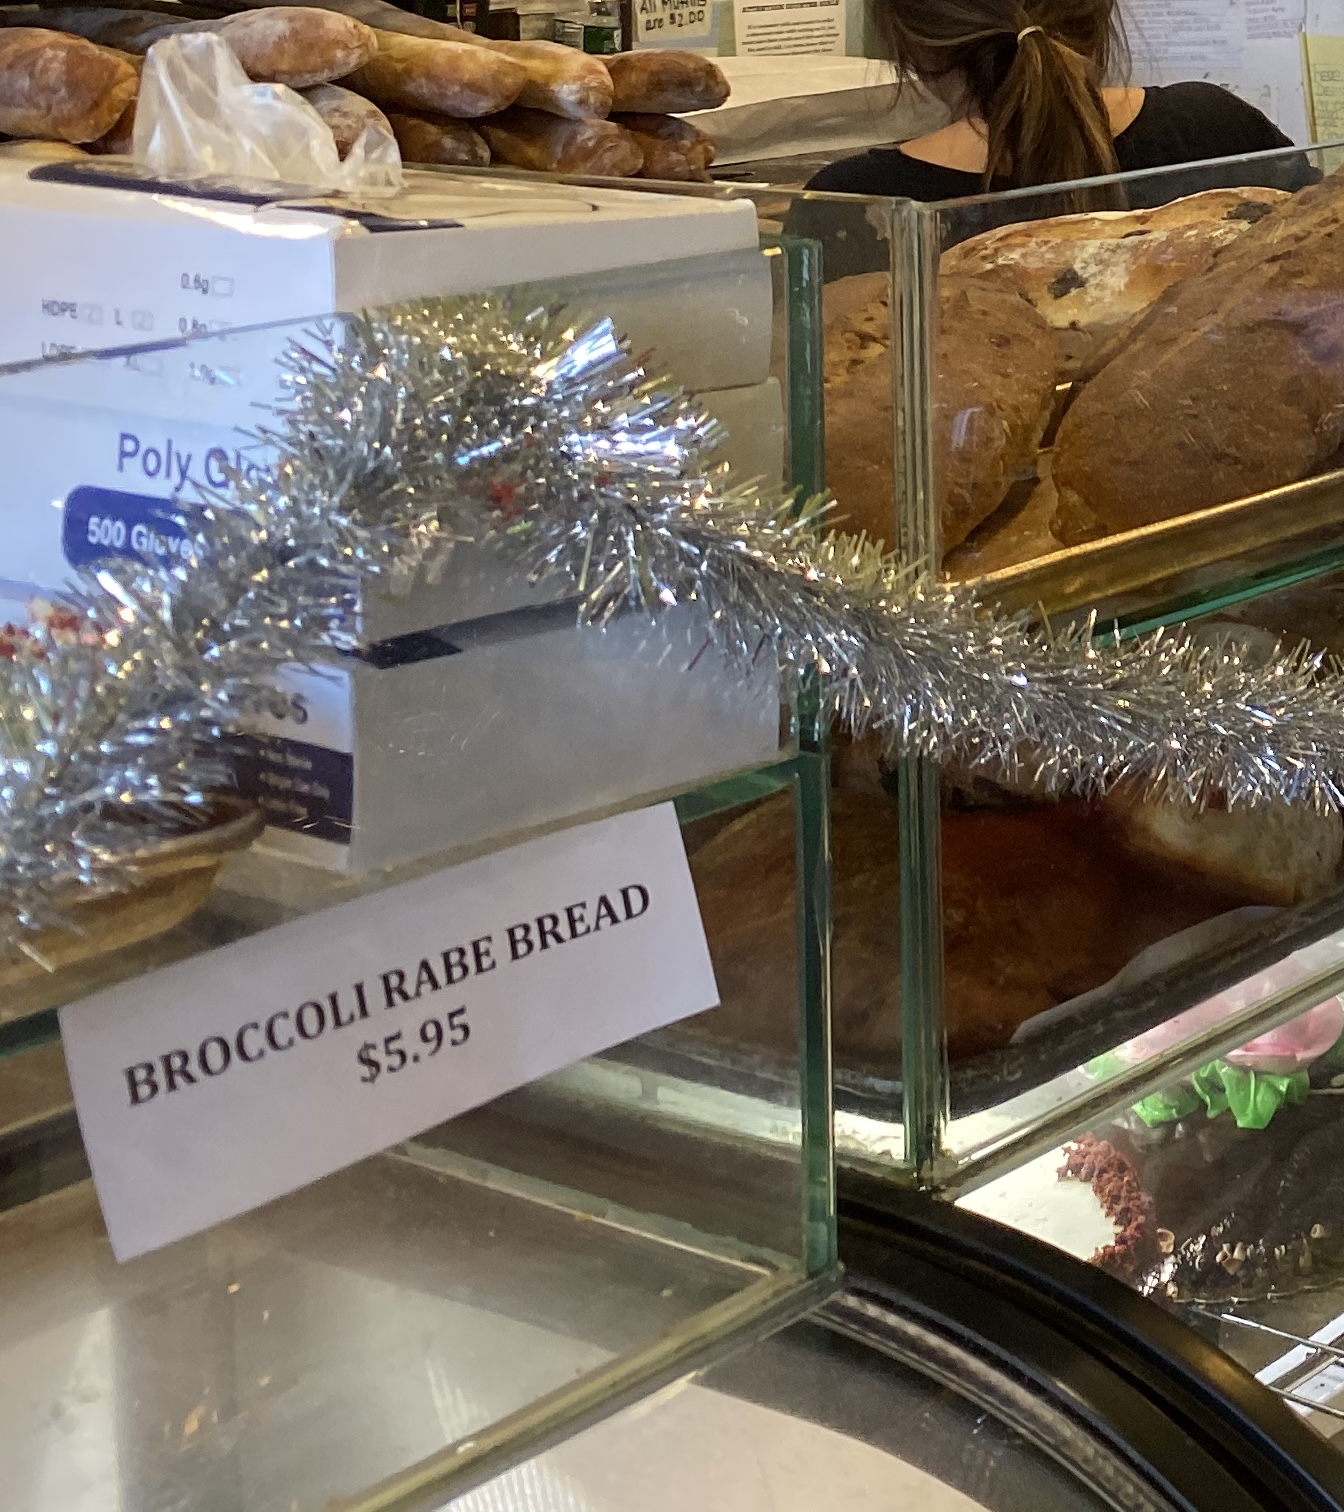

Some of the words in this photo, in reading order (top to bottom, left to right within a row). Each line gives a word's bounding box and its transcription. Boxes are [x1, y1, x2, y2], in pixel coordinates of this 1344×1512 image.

[645, 16, 664, 31] are
[669, 9, 705, 28] $2.00
[117, 432, 192, 493] Poly
[87, 515, 126, 549] 500
[122, 980, 372, 1108] BROCCOLI
[378, 934, 498, 1011] RABE
[504, 882, 651, 965] BREAD
[356, 1005, 472, 1085] $5.95
